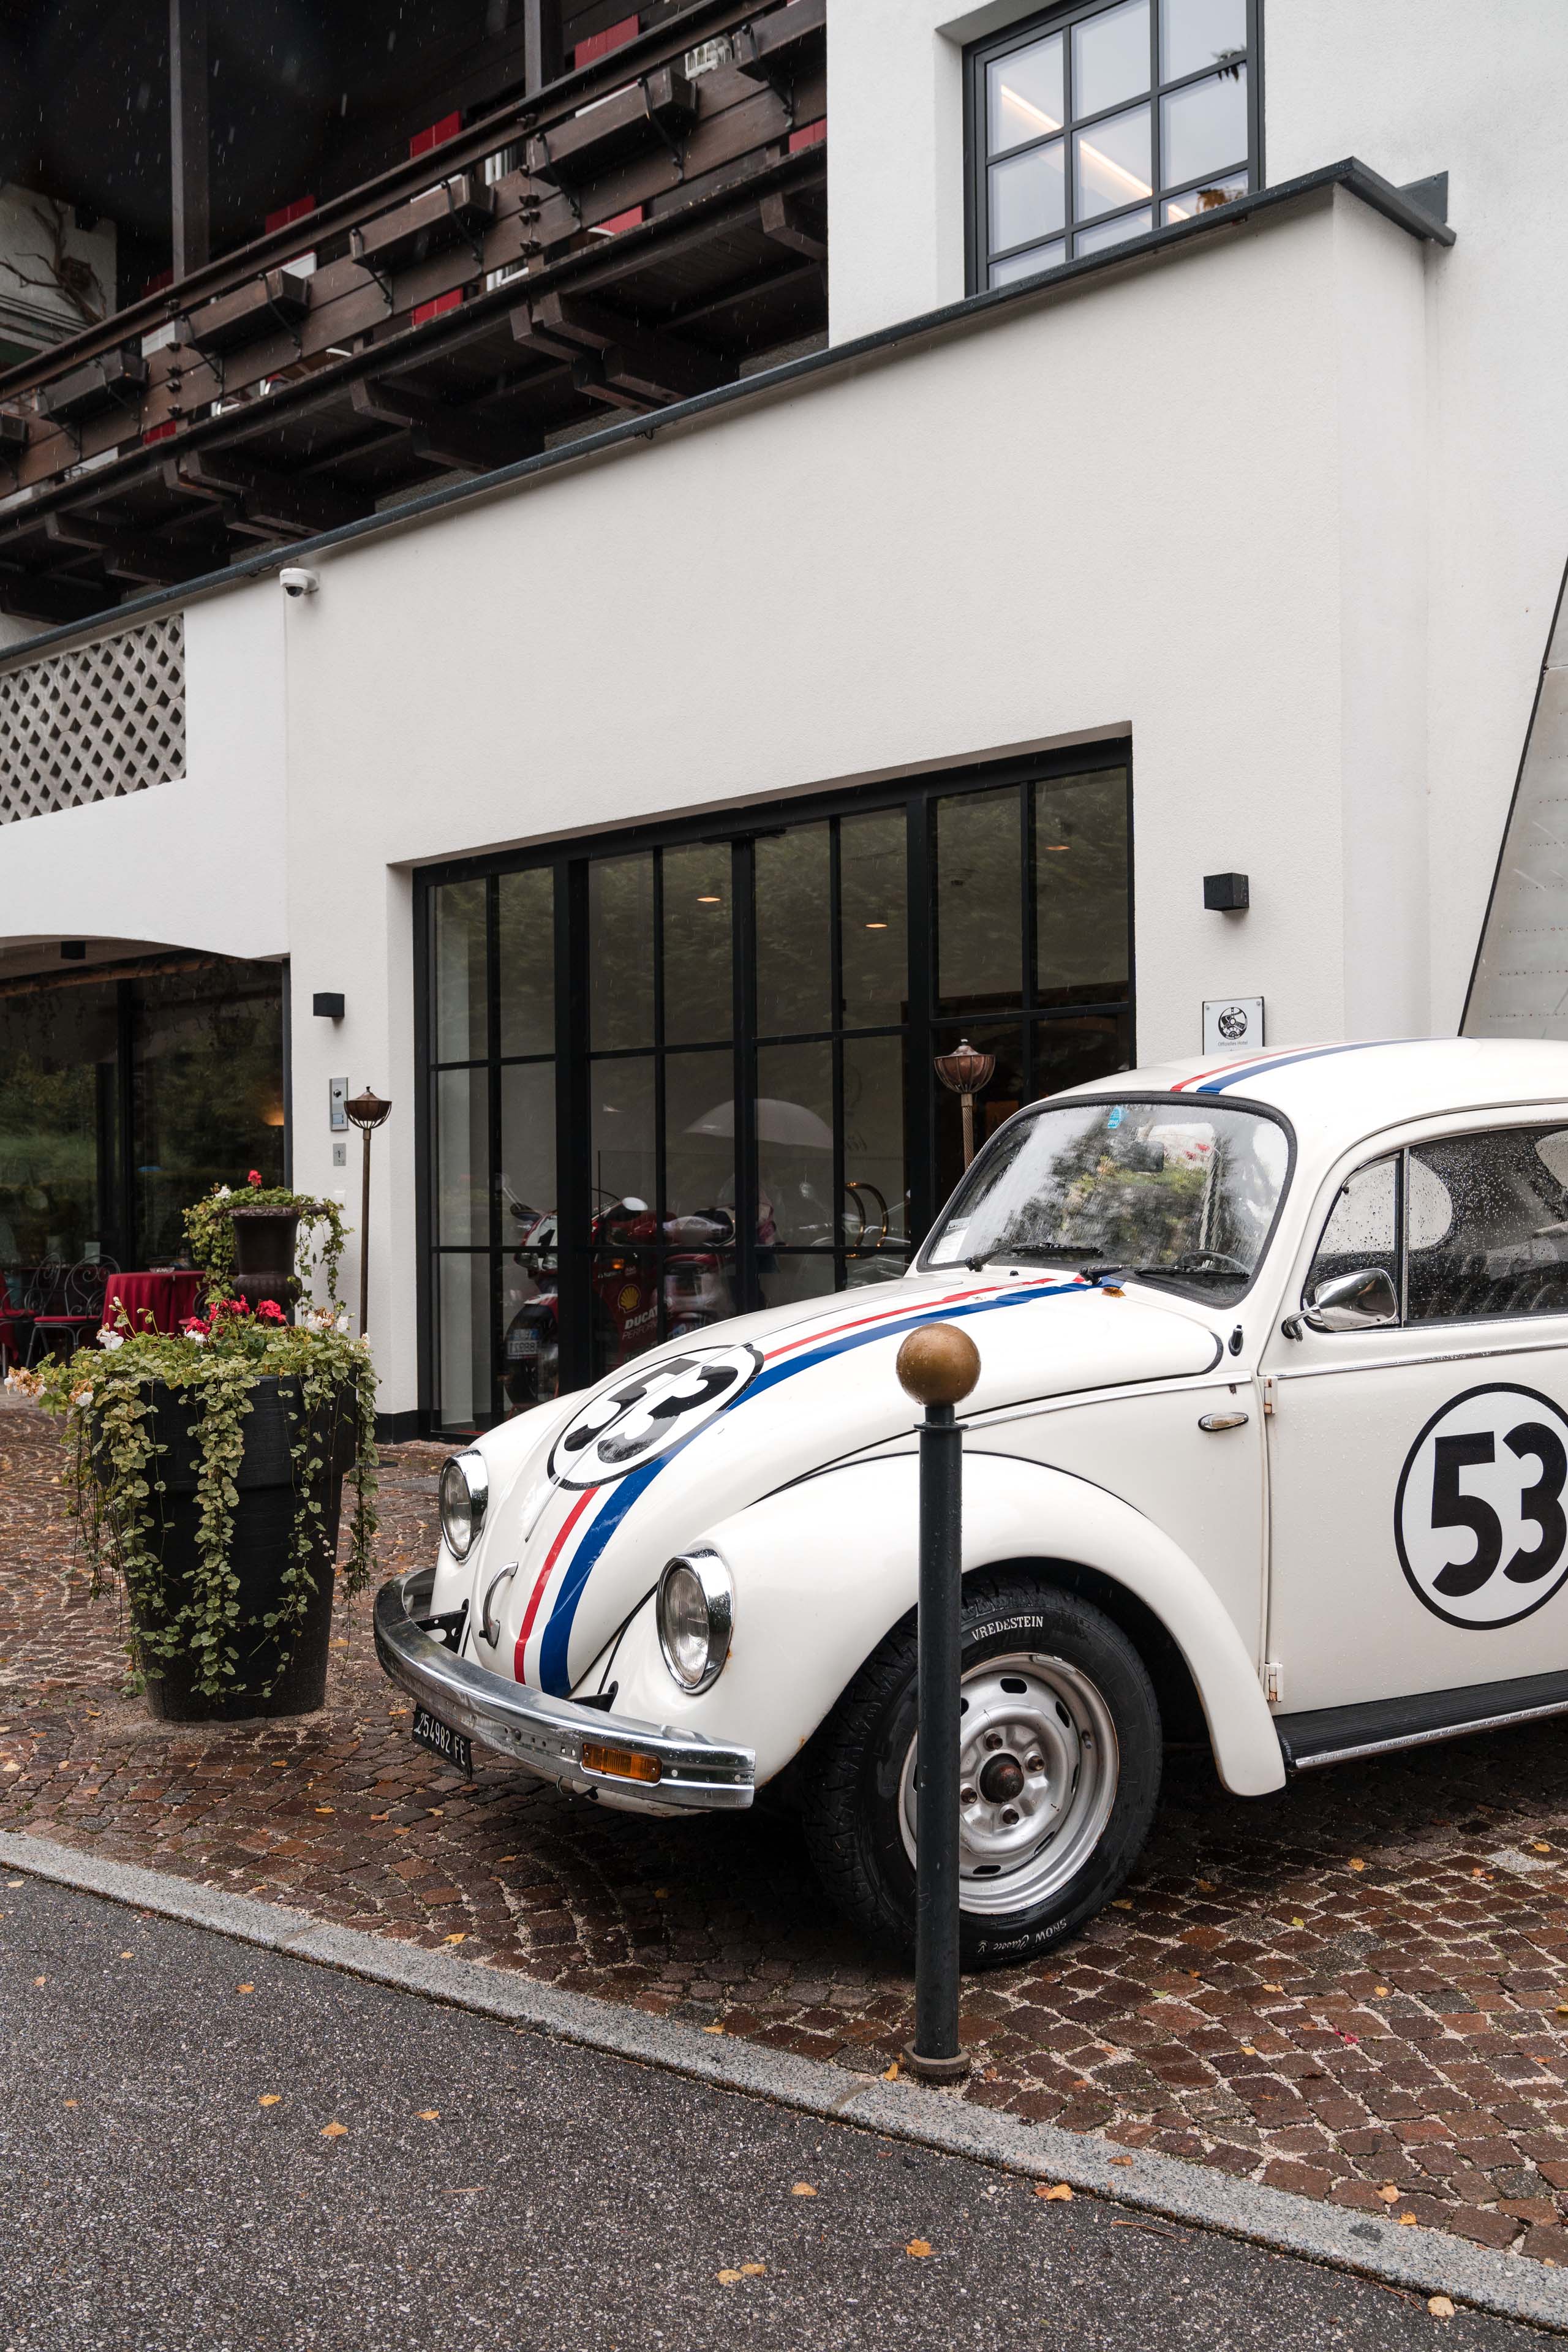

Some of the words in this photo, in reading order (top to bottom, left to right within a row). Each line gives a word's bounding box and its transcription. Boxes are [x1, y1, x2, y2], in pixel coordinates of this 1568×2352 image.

[624, 1305, 658, 1330] DUCAT
[564, 1358, 738, 1463] 53
[1431, 1422, 1567, 1597] 53
[971, 1616, 1044, 1641] VREDESTEIN
[413, 1713, 450, 1754] 254982
[454, 1735, 466, 1766] FE
[993, 1934, 1030, 1951] Classic
[1035, 1918, 1067, 1943] SNOW
